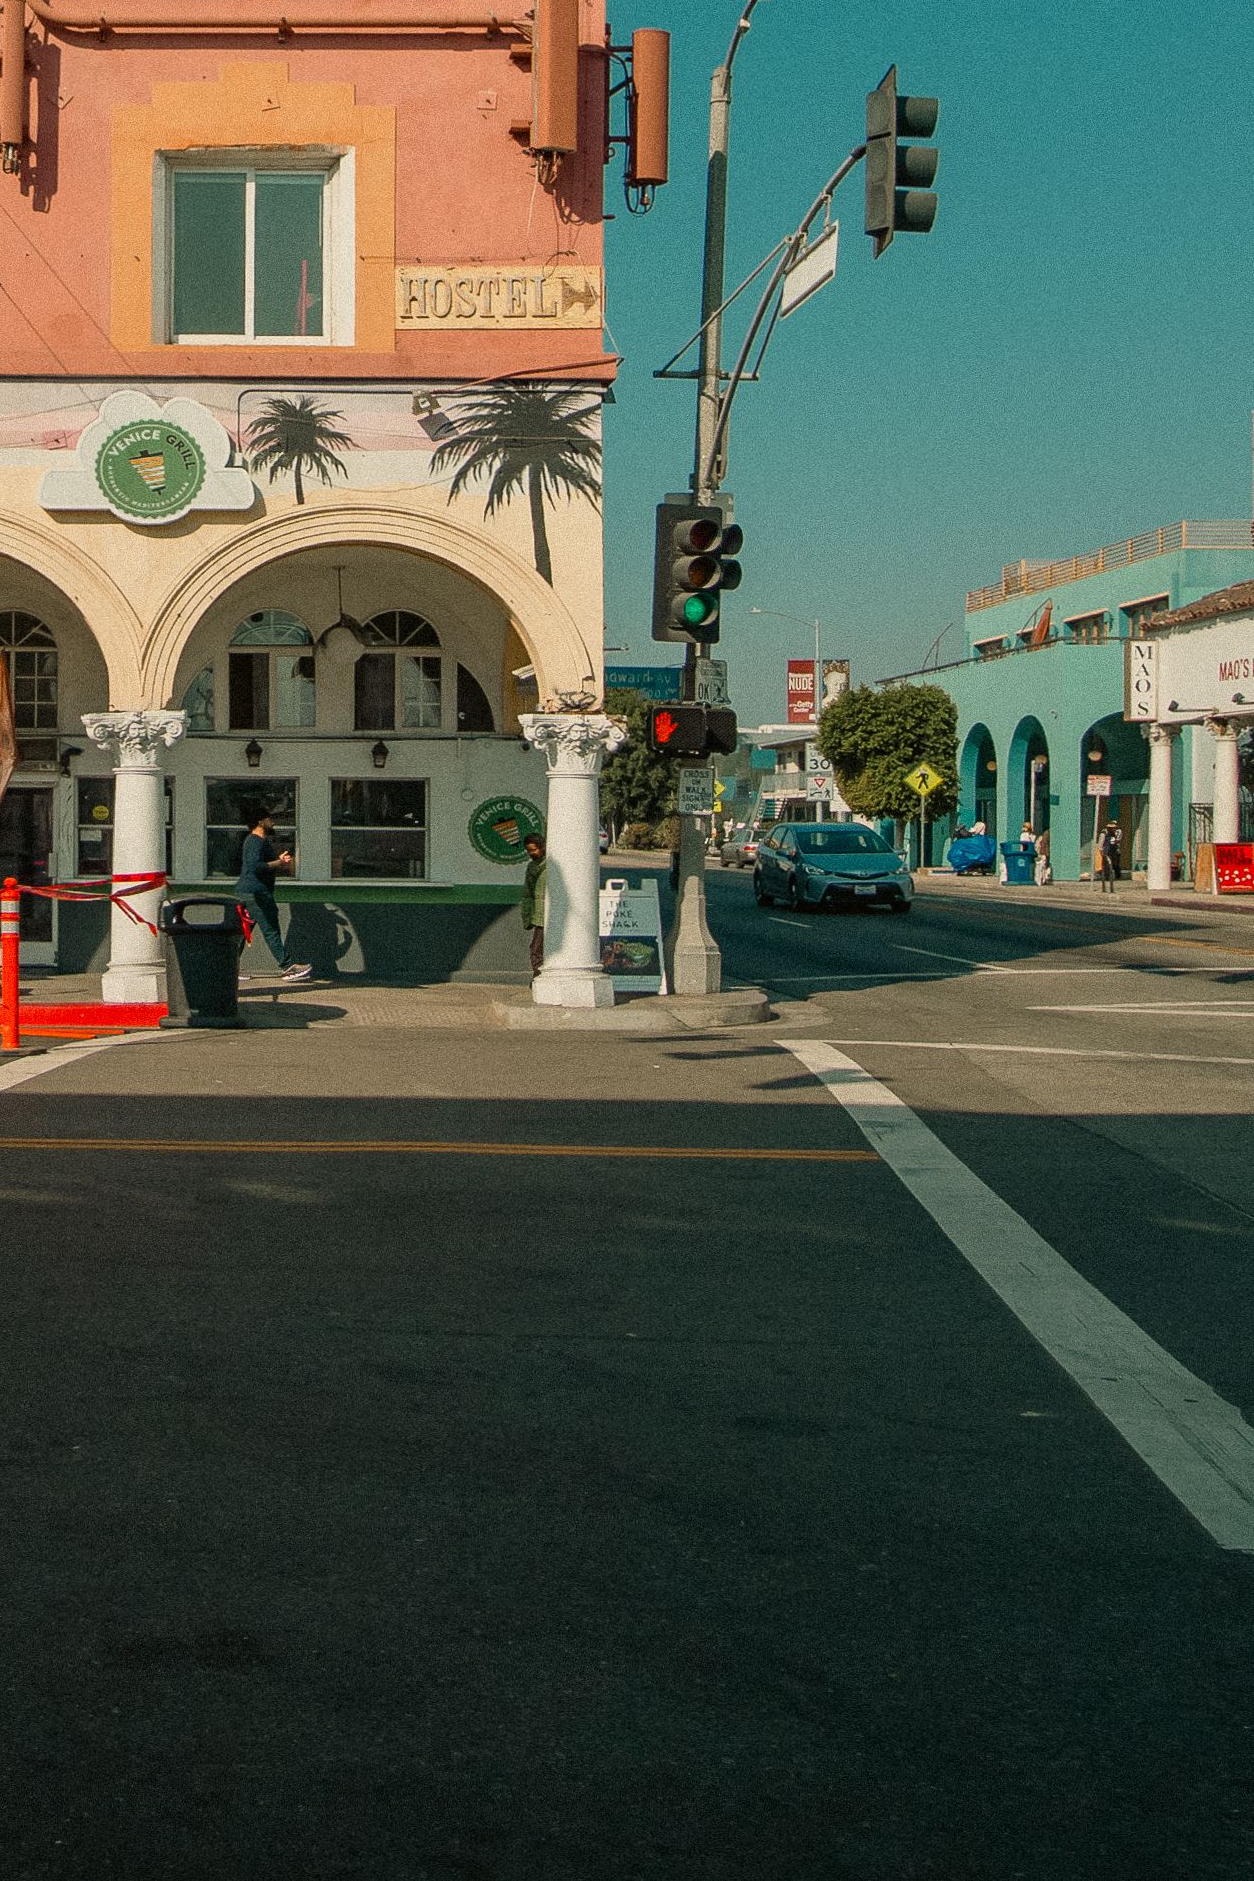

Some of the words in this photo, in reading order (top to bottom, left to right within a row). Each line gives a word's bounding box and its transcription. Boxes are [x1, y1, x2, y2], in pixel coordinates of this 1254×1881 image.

[401, 276, 557, 318] HOSTEL
[108, 429, 161, 456] VENICE
[166, 434, 196, 470] GRILL
[1219, 659, 1249, 681] MAO'S
[788, 677, 813, 690] NUDE
[809, 758, 831, 771] 30
[476, 802, 510, 825] VENICE
[514, 803, 539, 827] GRILL
[609, 900, 628, 908] THE
